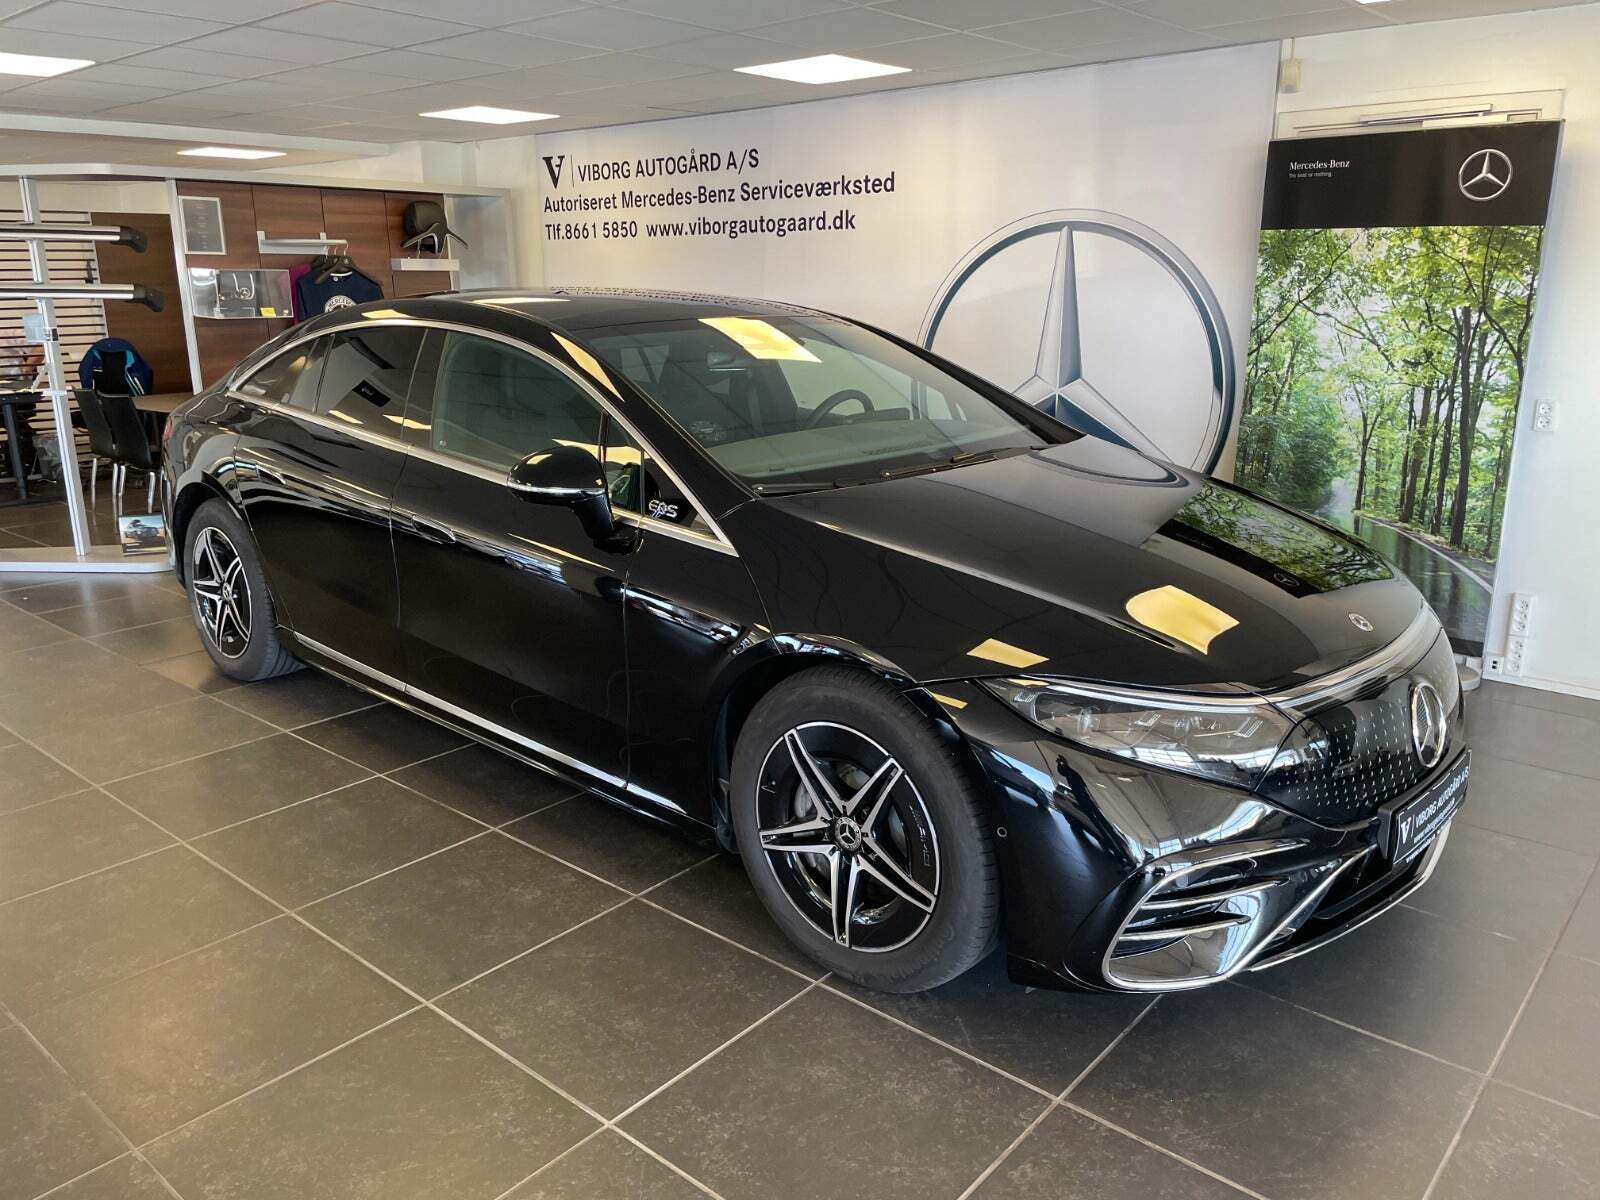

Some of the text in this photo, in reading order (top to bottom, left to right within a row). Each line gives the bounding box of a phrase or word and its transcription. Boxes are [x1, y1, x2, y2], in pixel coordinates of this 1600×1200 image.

[577, 161, 631, 182] VIBORG
[635, 148, 722, 178] AUTOGÅRD
[726, 148, 760, 175] A/S
[1289, 159, 1351, 170] Mercedes-Benz
[544, 171, 895, 213] Autoriseret Mercedes-Benz Serviceværksted
[545, 209, 856, 240] Tlf.8661 5850 www.viborgautogaard.dk
